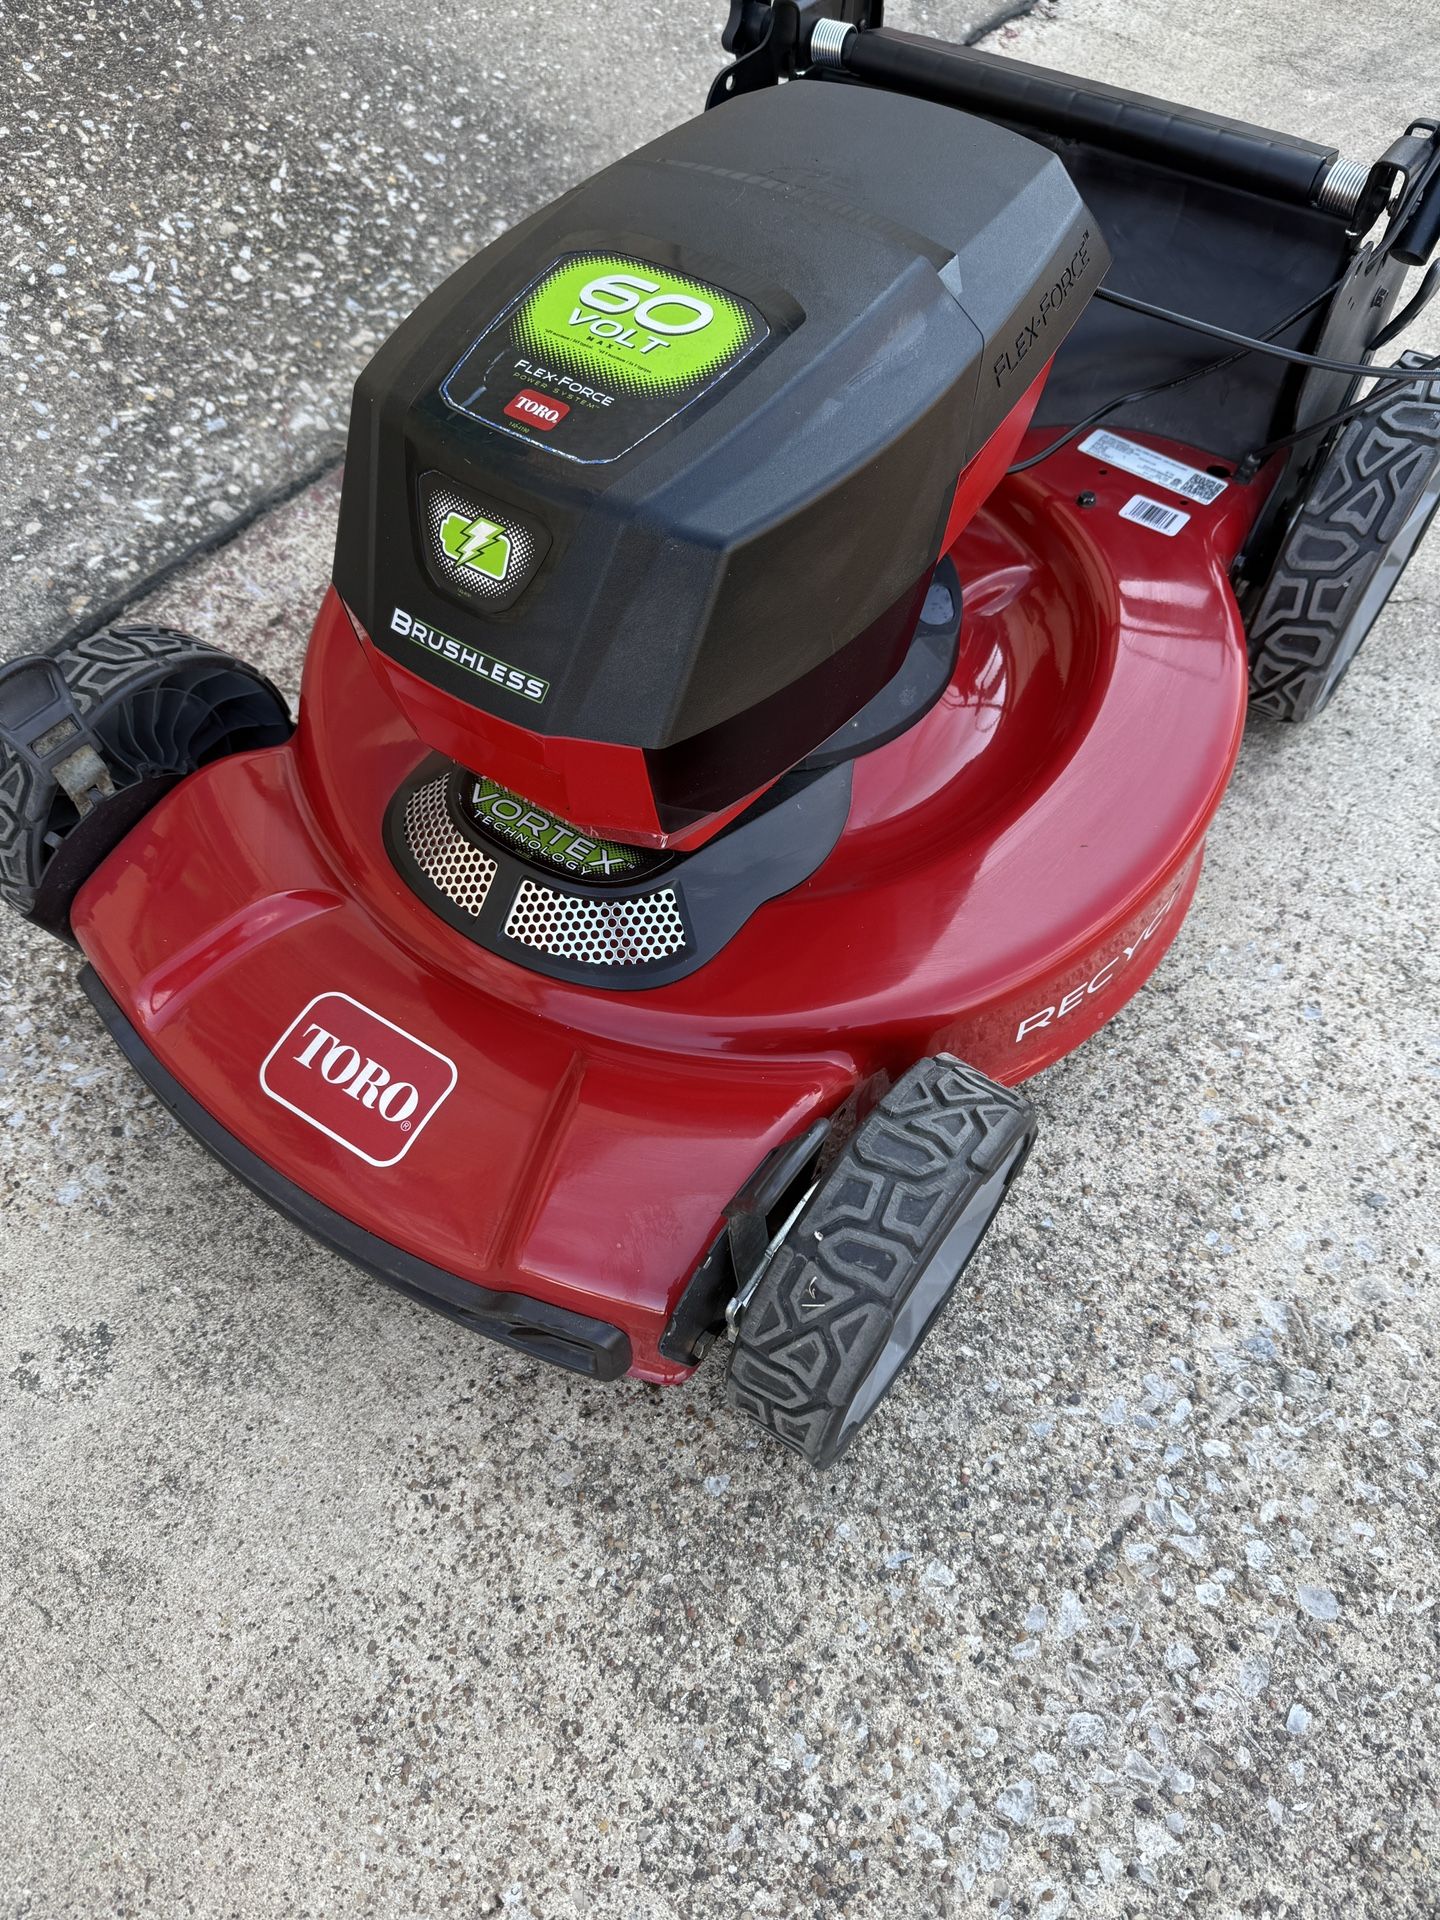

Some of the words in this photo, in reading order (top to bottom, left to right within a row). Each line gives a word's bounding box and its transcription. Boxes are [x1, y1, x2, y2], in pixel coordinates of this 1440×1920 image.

[567, 307, 670, 355] VOLT
[579, 273, 714, 336] 60
[513, 371, 549, 389] POWER
[514, 359, 615, 407] FLEX-FORCE
[514, 396, 560, 422] TORO
[390, 607, 545, 699] BRUSHLESS
[471, 782, 625, 875] VORTEX
[473, 809, 592, 876] TECHNOLOGY
